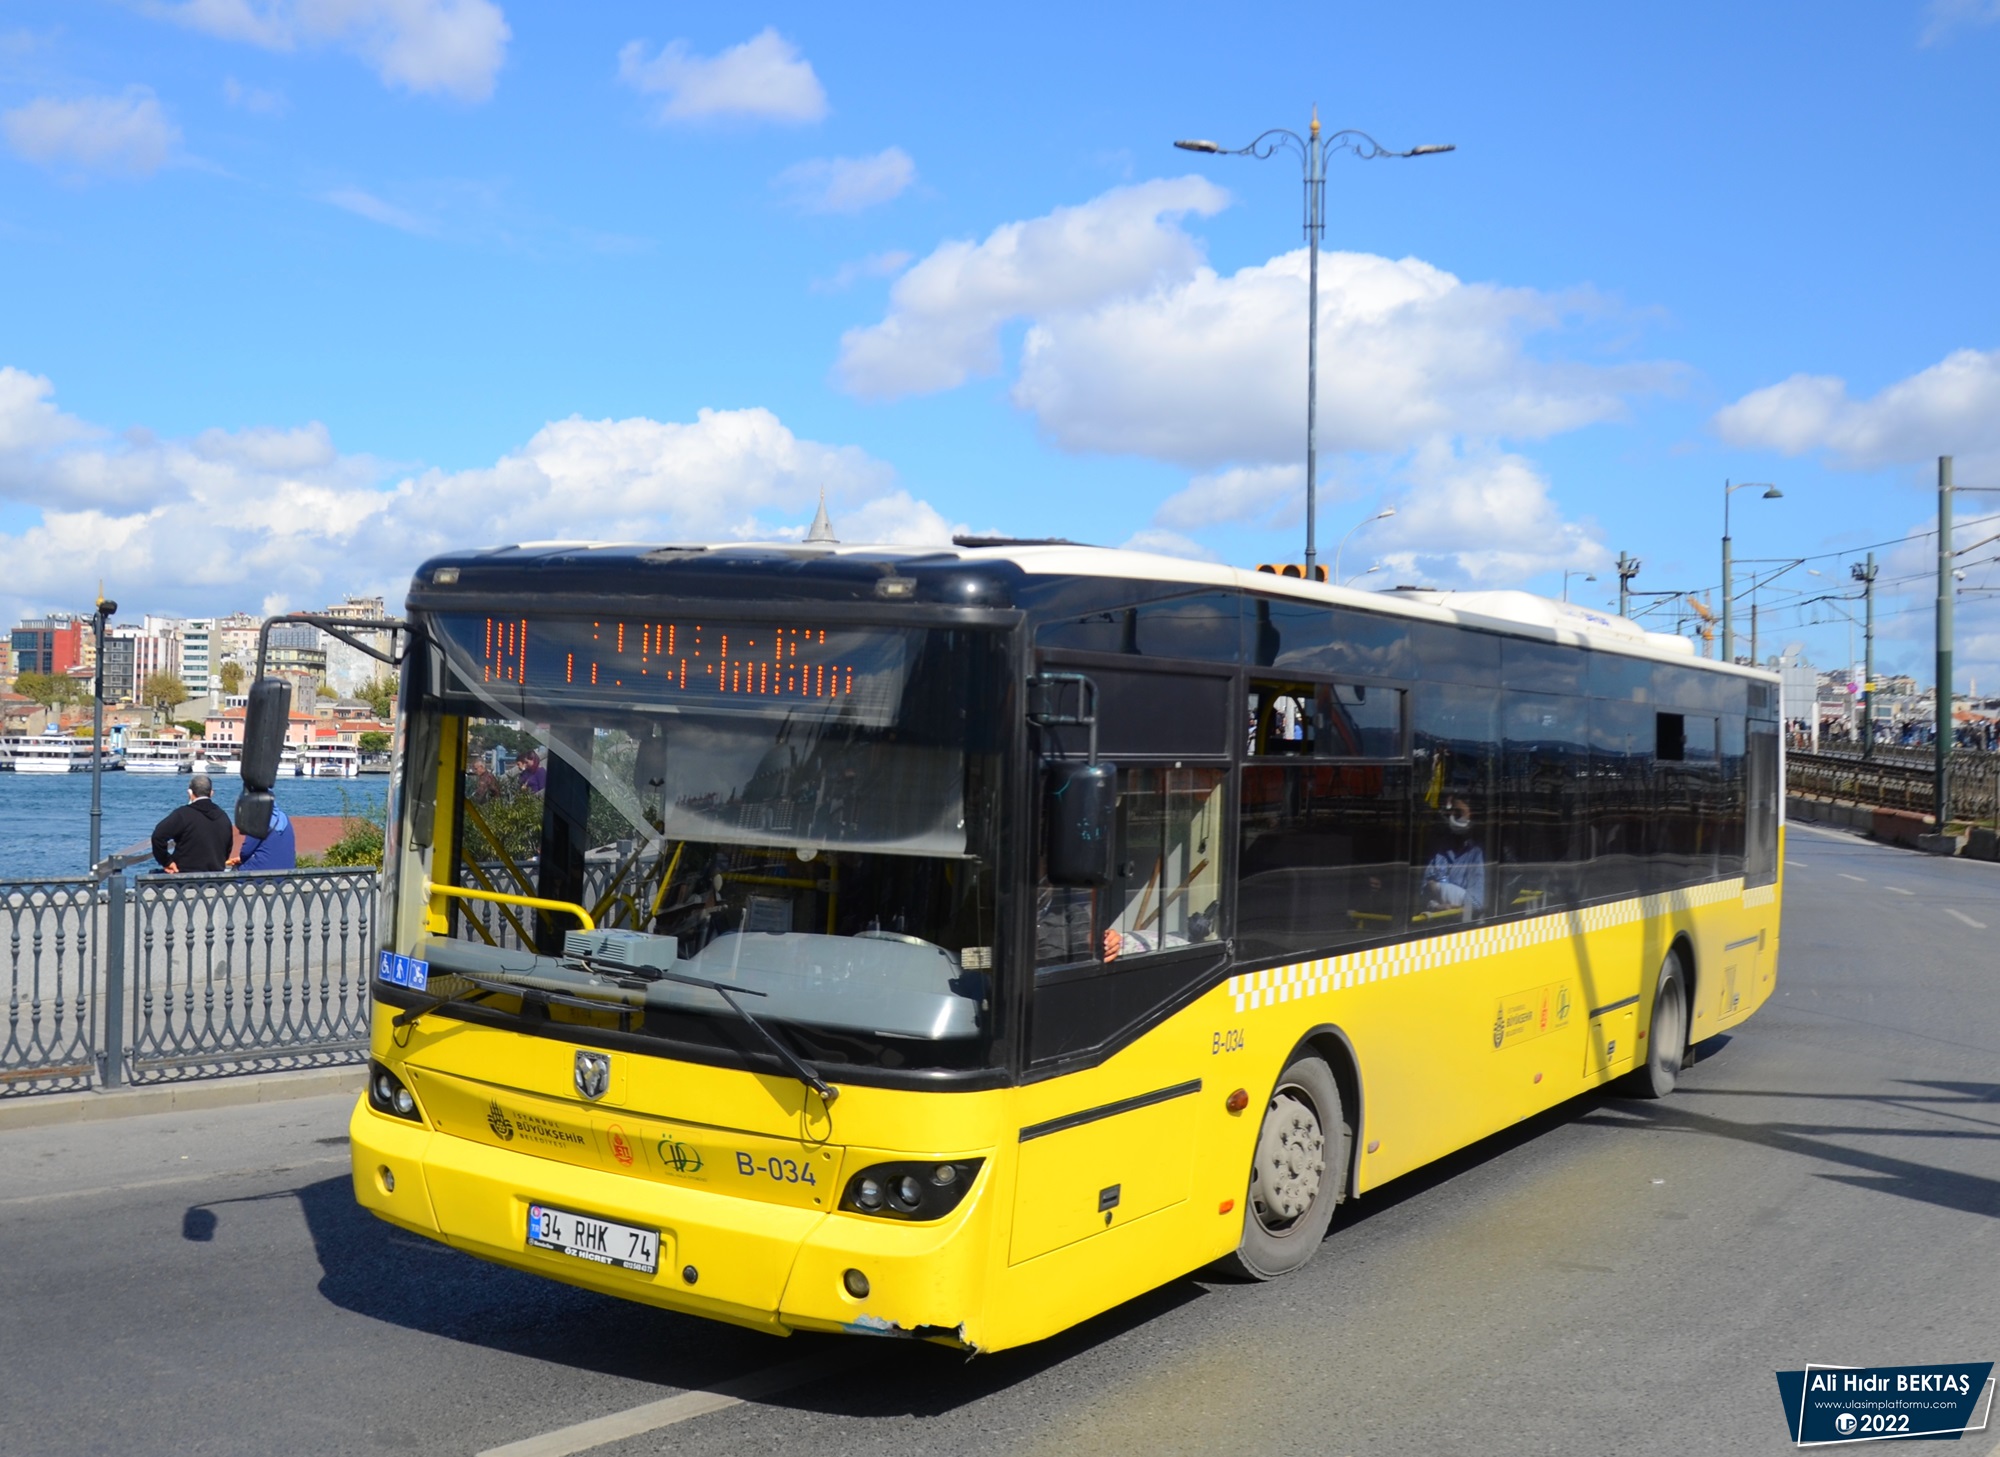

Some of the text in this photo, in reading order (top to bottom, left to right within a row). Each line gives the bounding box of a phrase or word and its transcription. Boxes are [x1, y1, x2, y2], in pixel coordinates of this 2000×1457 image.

[1212, 1028, 1244, 1055] B-034
[736, 1151, 816, 1186] B-034
[541, 1212, 651, 1262] 34 RHK 74
